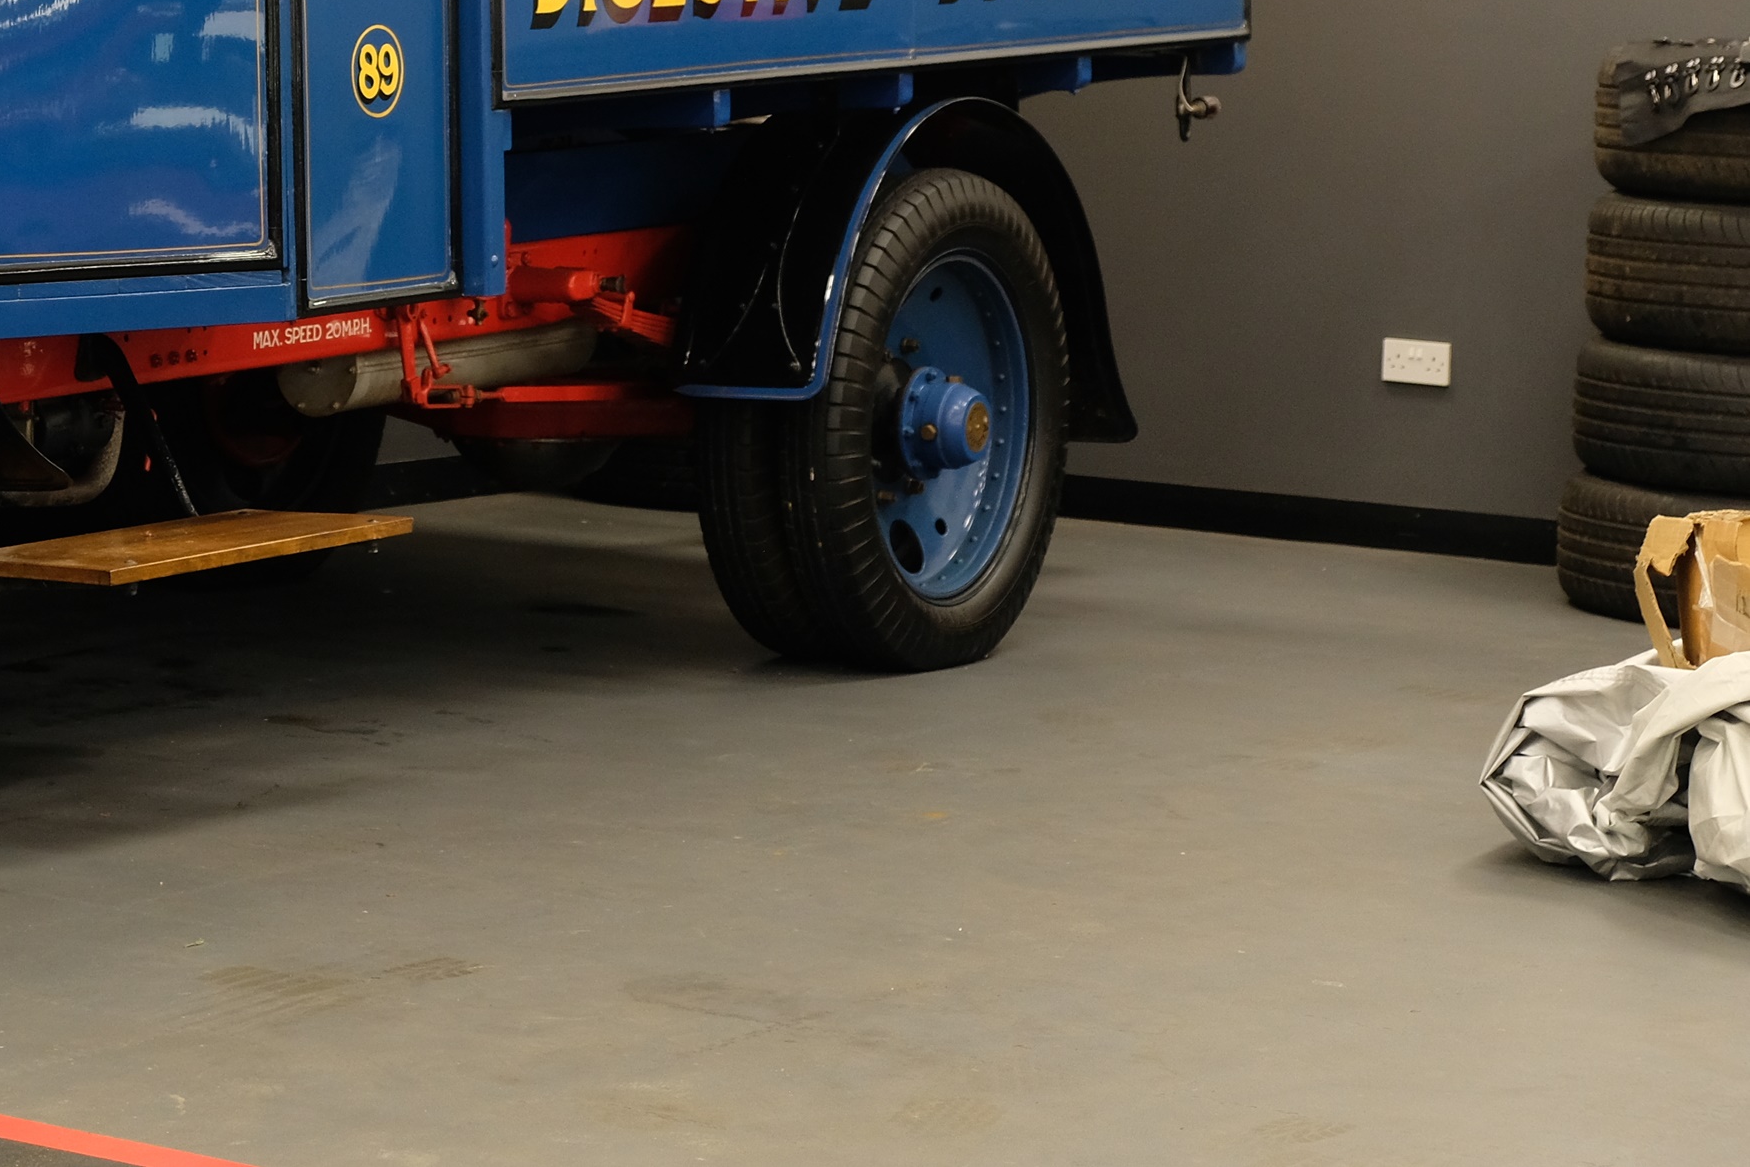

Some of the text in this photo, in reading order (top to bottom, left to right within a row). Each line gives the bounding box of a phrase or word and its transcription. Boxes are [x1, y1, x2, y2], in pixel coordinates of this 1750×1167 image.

[358, 42, 399, 100] 89
[253, 329, 283, 350] MAX.
[284, 323, 322, 345] SPEED
